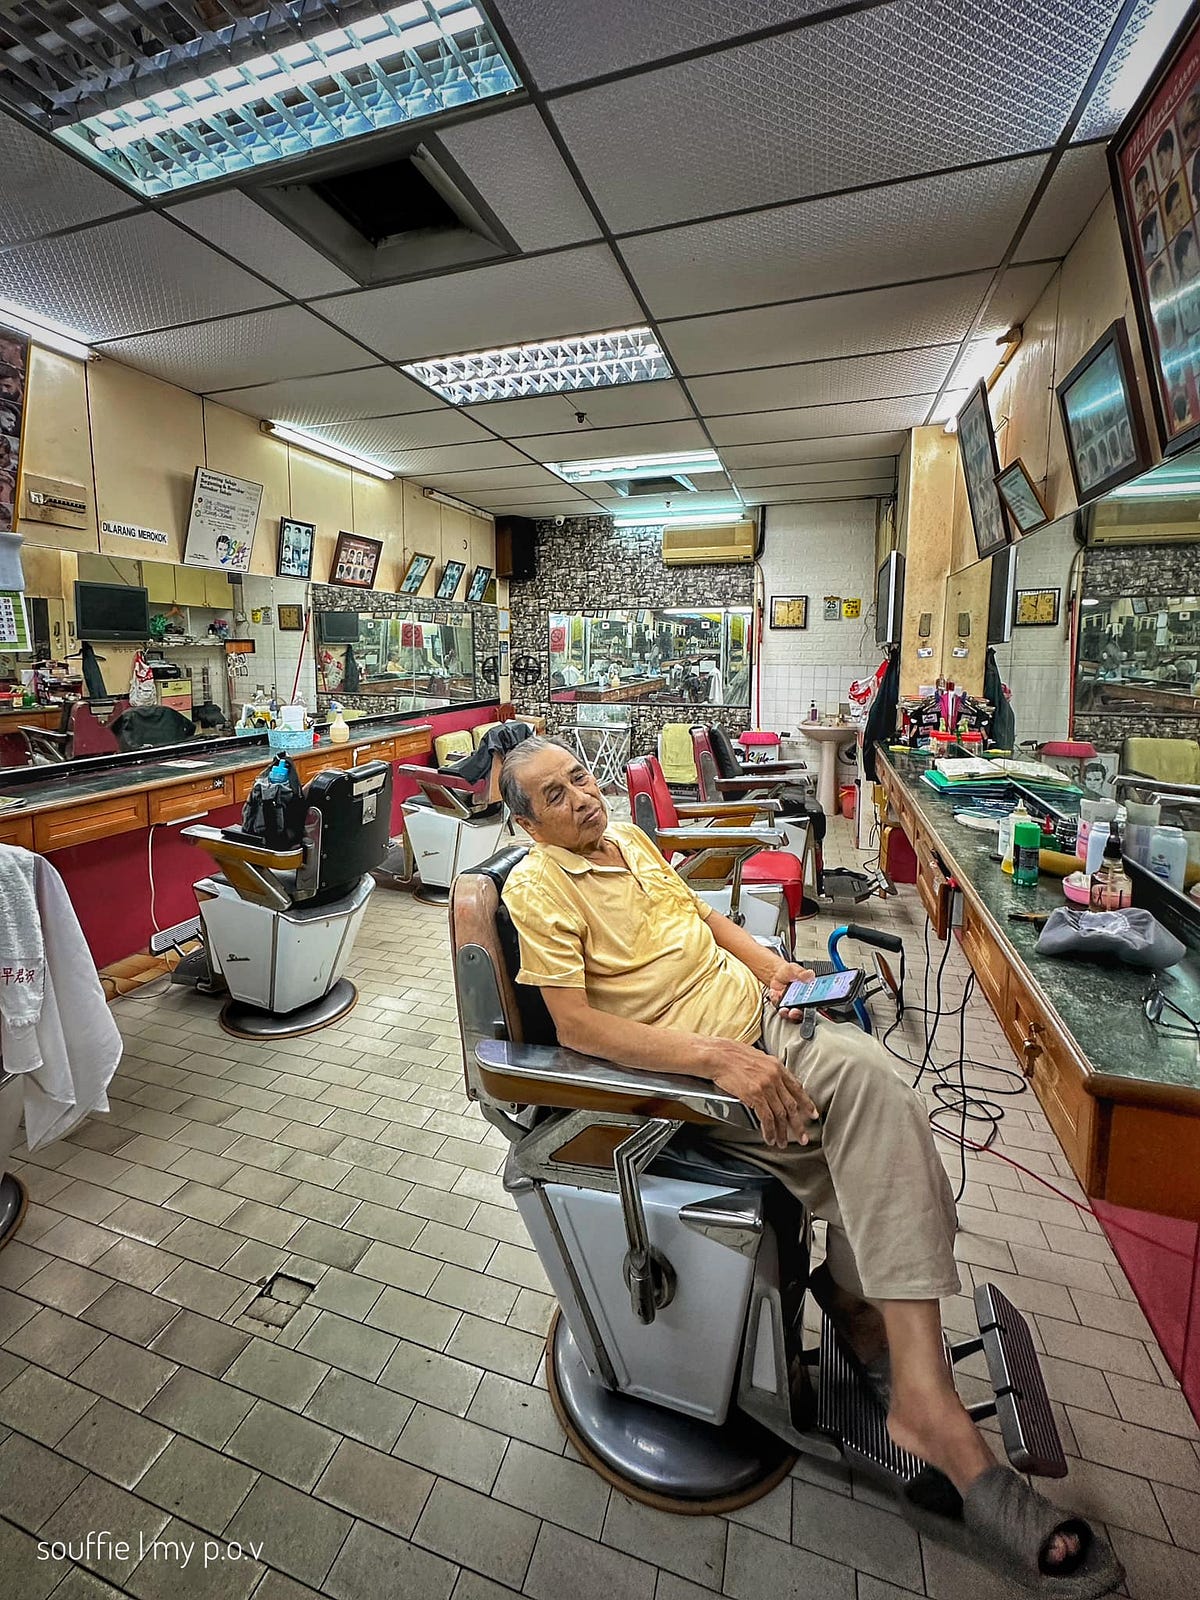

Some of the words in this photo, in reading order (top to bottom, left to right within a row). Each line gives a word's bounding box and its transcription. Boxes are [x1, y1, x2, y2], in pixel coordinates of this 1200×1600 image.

[102, 522, 136, 537] DILARANG
[138, 529, 167, 543] MEROKOK
[826, 601, 837, 609] 25
